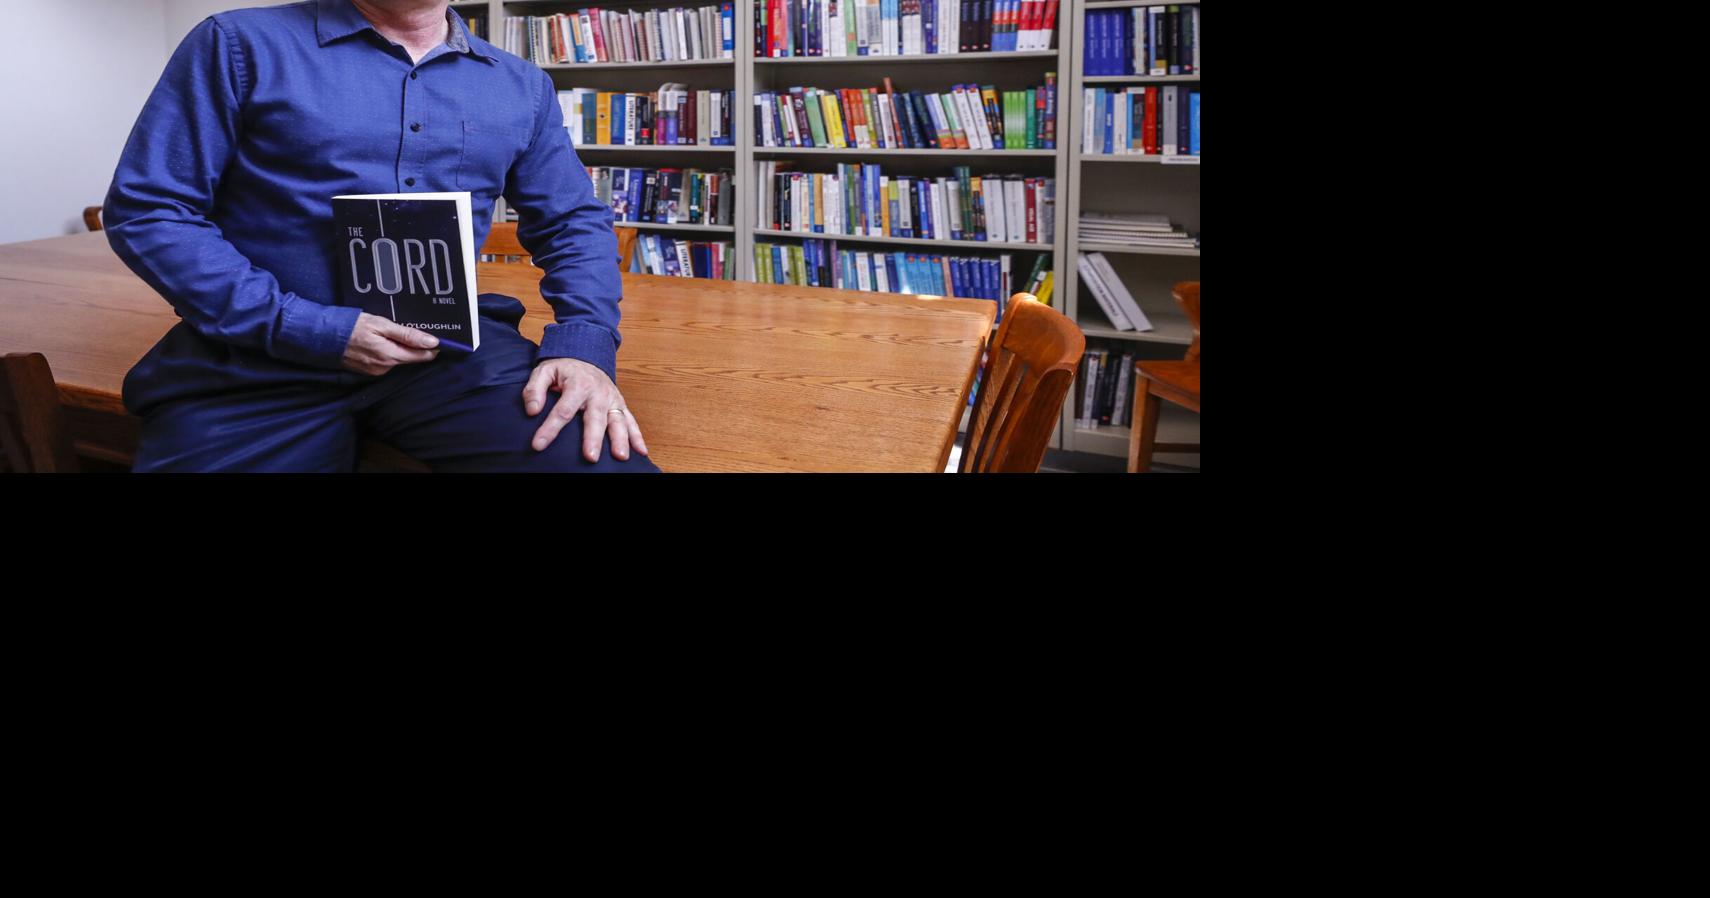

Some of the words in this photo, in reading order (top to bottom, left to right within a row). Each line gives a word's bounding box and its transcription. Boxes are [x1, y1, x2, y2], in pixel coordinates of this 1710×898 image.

[347, 227, 364, 237] THE
[349, 238, 454, 295] CORD
[680, 248, 691, 276] LITERATUR
[438, 297, 456, 305] NOVEL
[406, 322, 462, 330] O'LOUGHLIN
